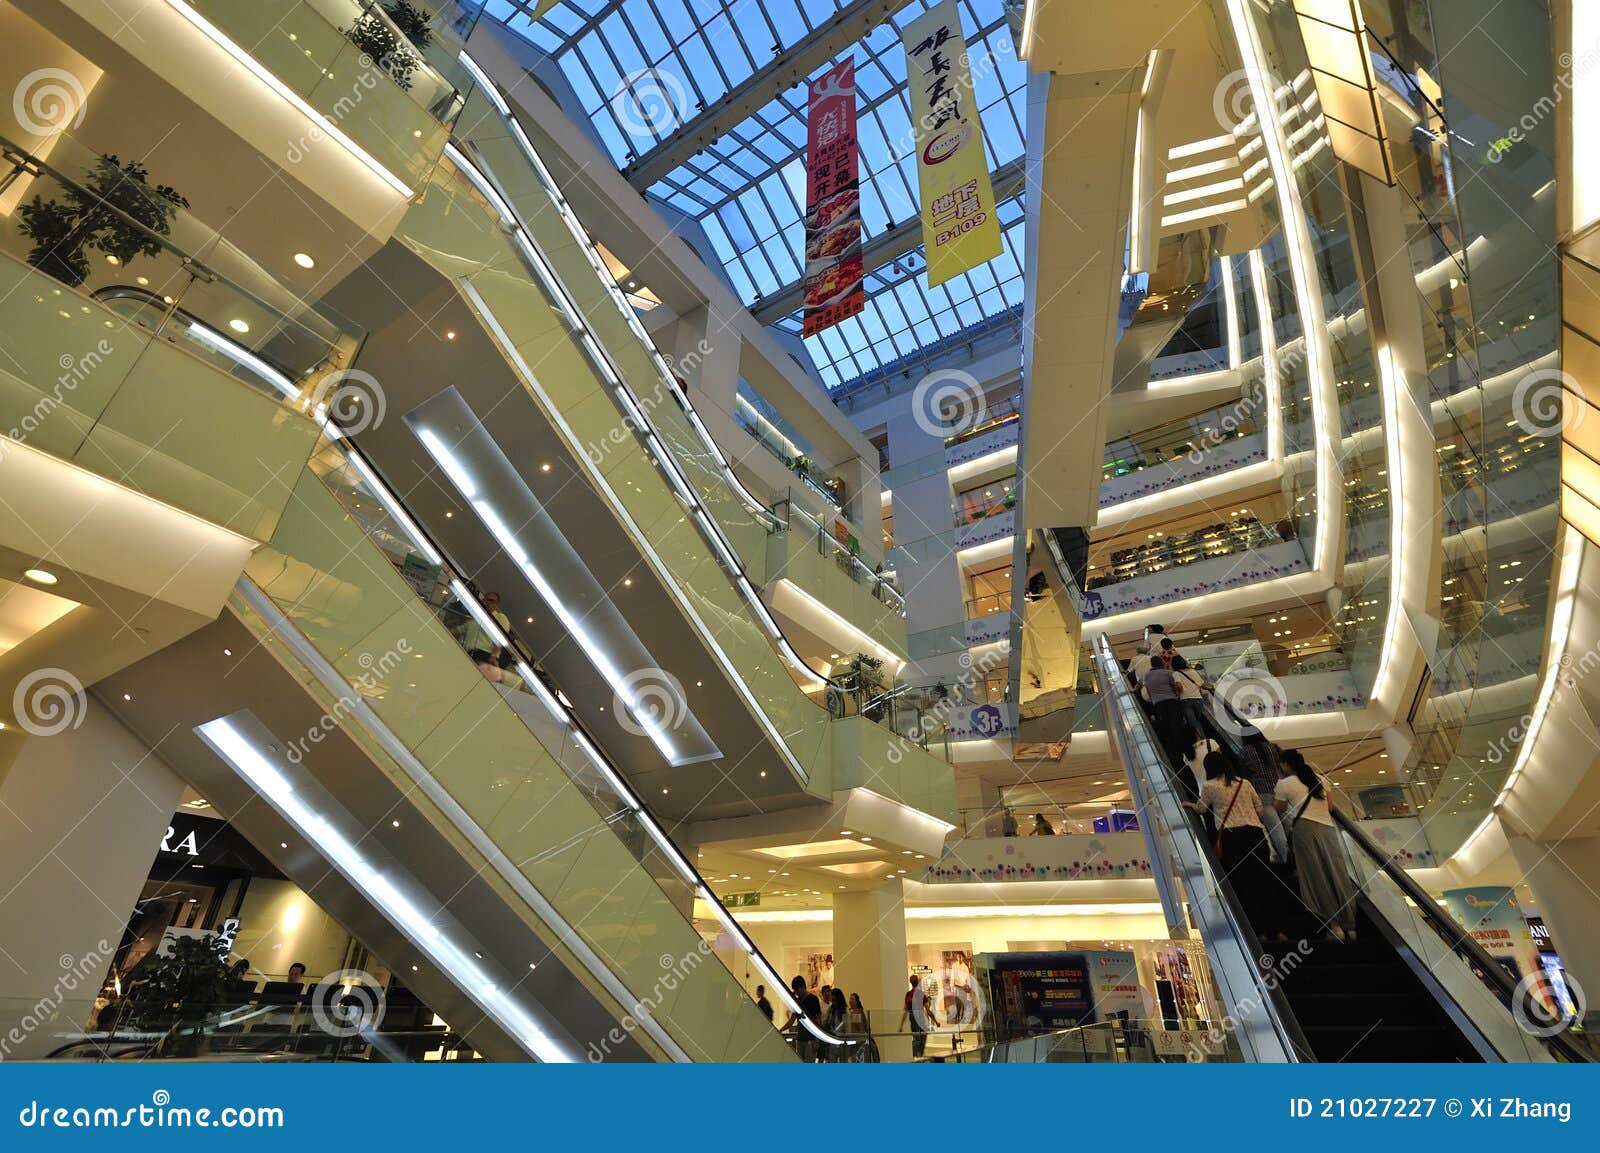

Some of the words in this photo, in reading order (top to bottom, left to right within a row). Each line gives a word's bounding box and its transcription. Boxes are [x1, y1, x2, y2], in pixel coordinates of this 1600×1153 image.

[931, 179, 978, 217] 地下
[936, 213, 987, 247] B109
[977, 710, 999, 733] 3F
